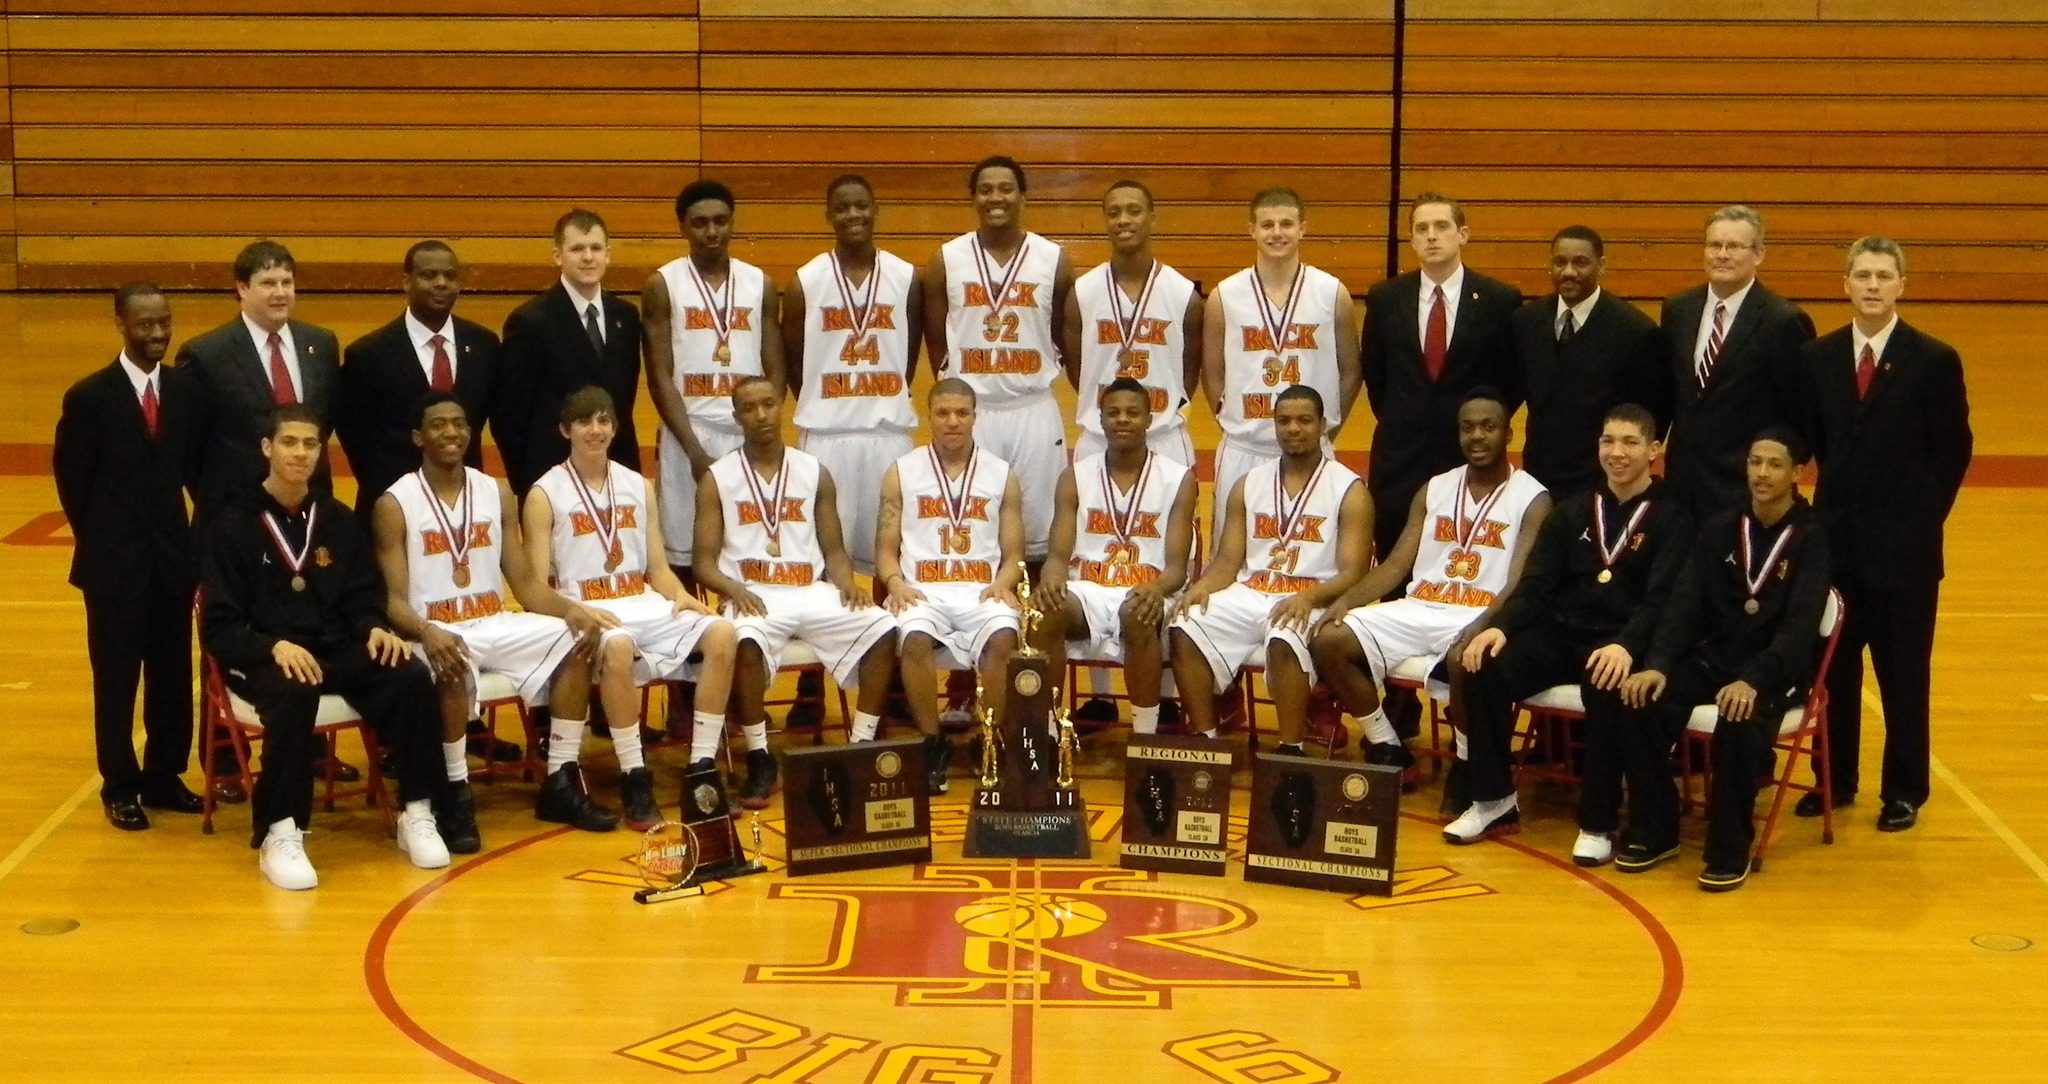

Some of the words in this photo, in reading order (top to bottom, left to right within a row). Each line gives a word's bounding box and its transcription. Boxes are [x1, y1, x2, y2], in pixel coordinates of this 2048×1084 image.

[983, 312, 1020, 343] 32
[840, 335, 880, 365] 44
[960, 348, 1041, 375] ISLAND
[1262, 355, 1301, 386] 34
[683, 373, 746, 396] ISLA
[821, 371, 903, 399] ISLAND
[736, 558, 814, 587] ISLAND
[915, 559, 992, 584] ISLAND
[1444, 548, 1482, 581] 33
[577, 570, 645, 601] ISLAN
[425, 590, 501, 624] ISLAND
[1140, 747, 1220, 763] REGIONAL
[980, 791, 1000, 806] 20
[1055, 791, 1073, 806] 11
[1013, 815, 1072, 825] CHAMPIONS
[1127, 844, 1221, 860] CHAMPIONS
[1257, 855, 1314, 871] SECTIONAL
[1320, 863, 1381, 878] CHAMPIONS
